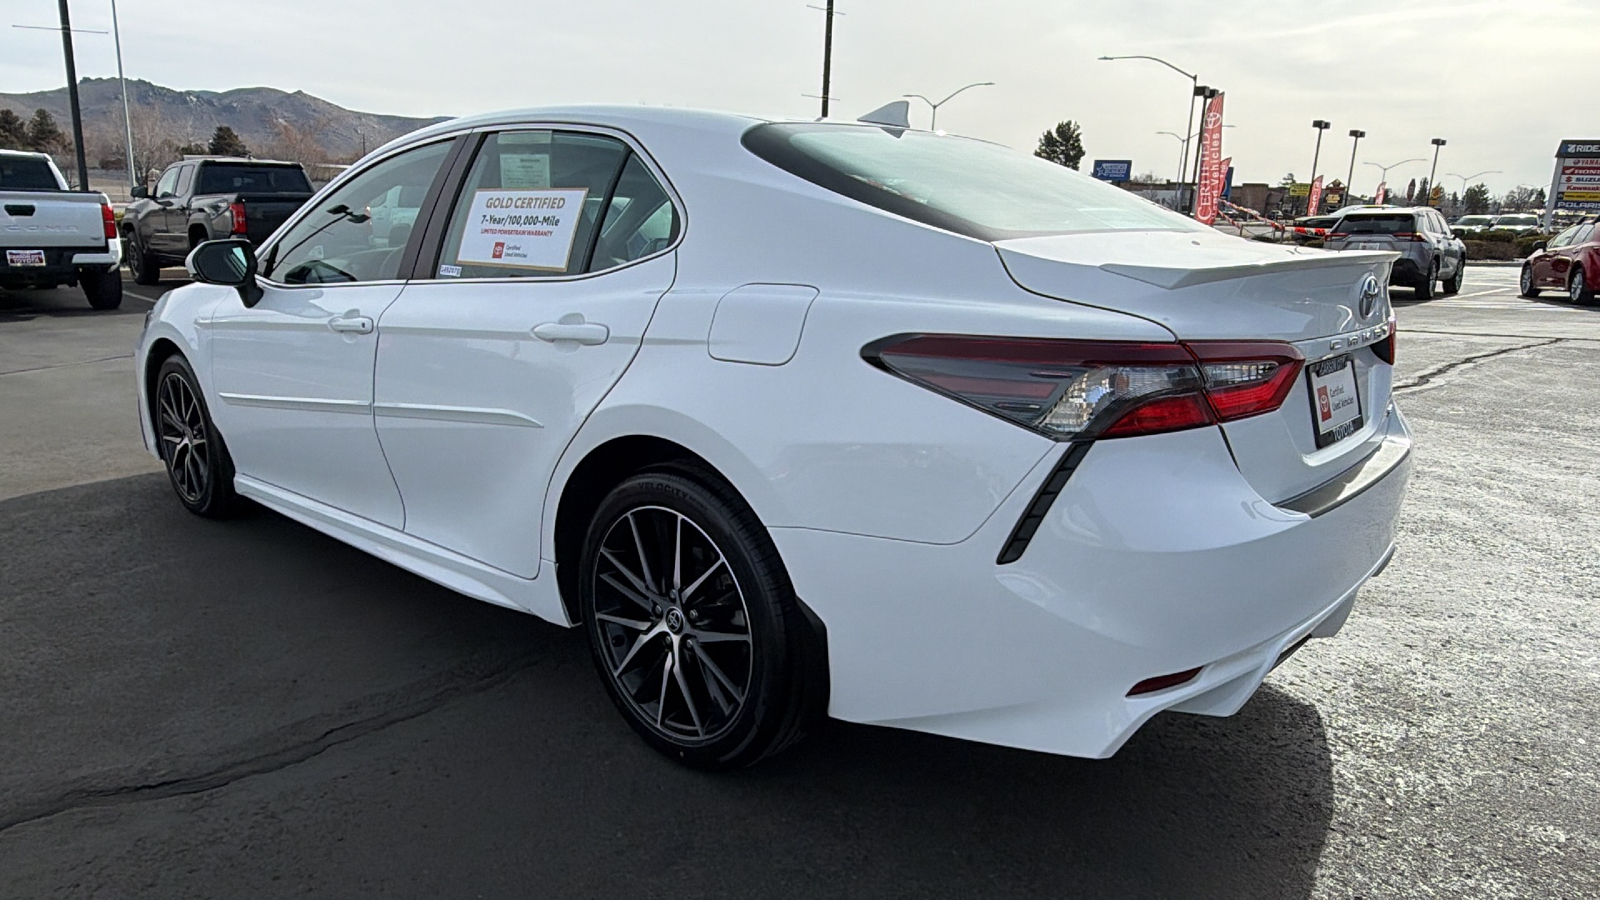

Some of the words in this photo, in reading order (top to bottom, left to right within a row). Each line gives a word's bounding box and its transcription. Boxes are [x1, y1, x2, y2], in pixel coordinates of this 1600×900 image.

[1211, 133, 1219, 185] Vehicles
[486, 197, 513, 209] GOLD
[514, 197, 566, 209] CERTIFIED
[481, 214, 560, 227] 7-Year/100,000-Mile
[1329, 384, 1344, 398] Certified
[1332, 401, 1341, 412] Used
[1341, 396, 1354, 408] Vehicles
[1333, 420, 1354, 441] TOYOTA
[638, 482, 688, 500] VELOCITY
